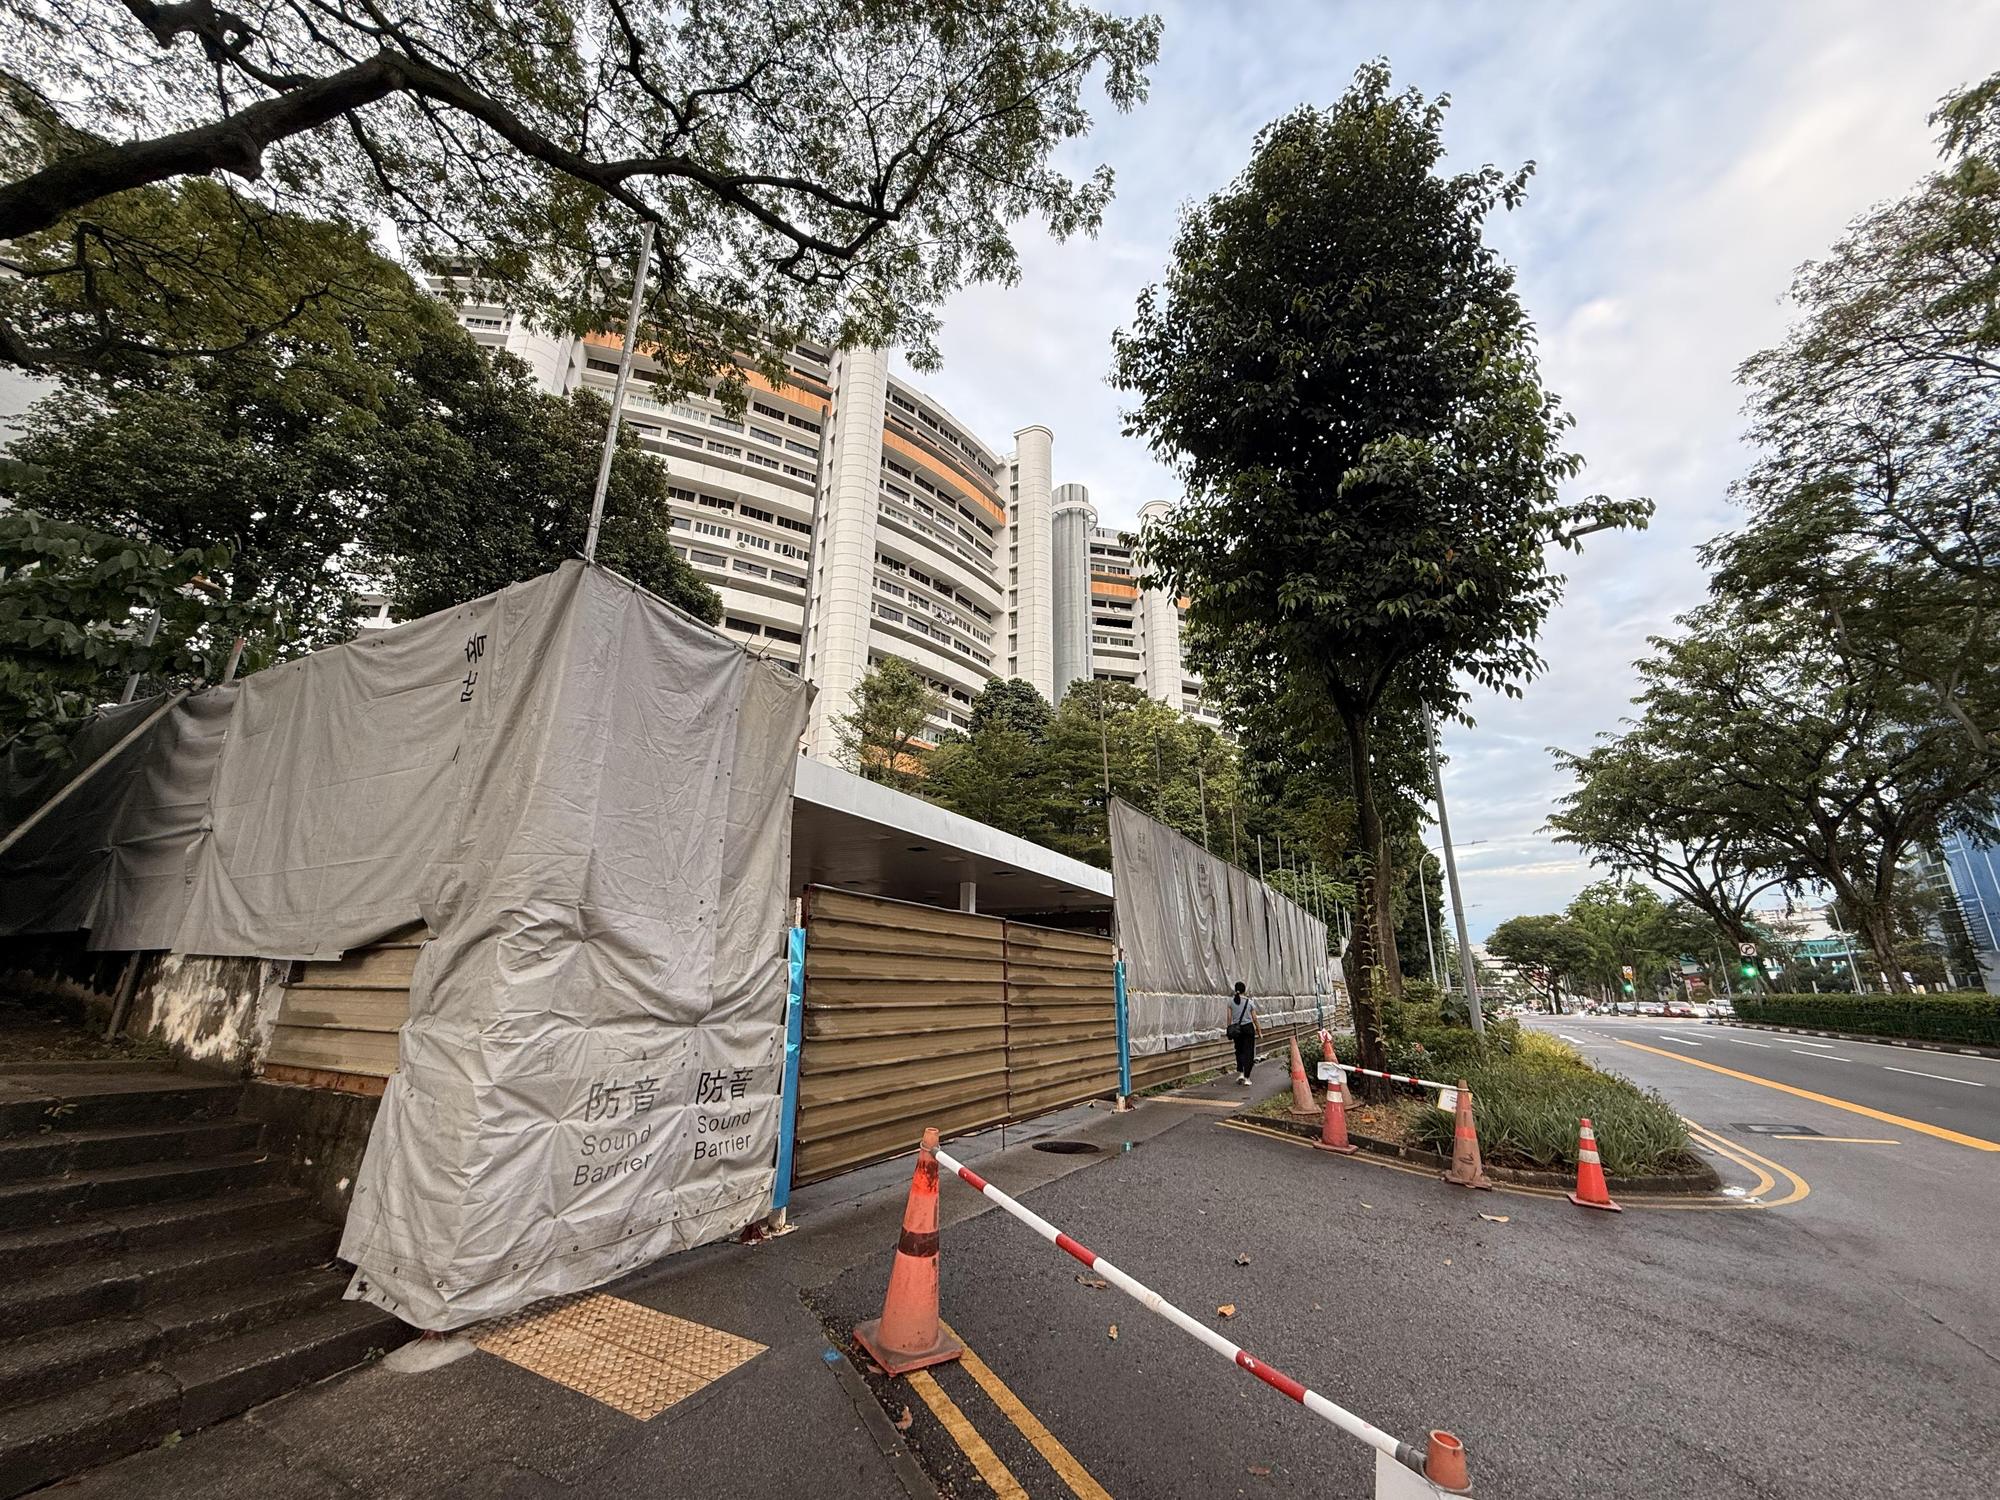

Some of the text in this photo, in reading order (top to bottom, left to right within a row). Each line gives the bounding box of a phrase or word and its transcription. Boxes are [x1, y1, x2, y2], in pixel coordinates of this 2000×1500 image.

[584, 1075, 661, 1122] 防音
[695, 1066, 754, 1105] 防音
[697, 1108, 752, 1134] Sound
[581, 1124, 652, 1157] Sound
[694, 1133, 752, 1160] Barrier
[573, 1153, 653, 1187] Barrier
